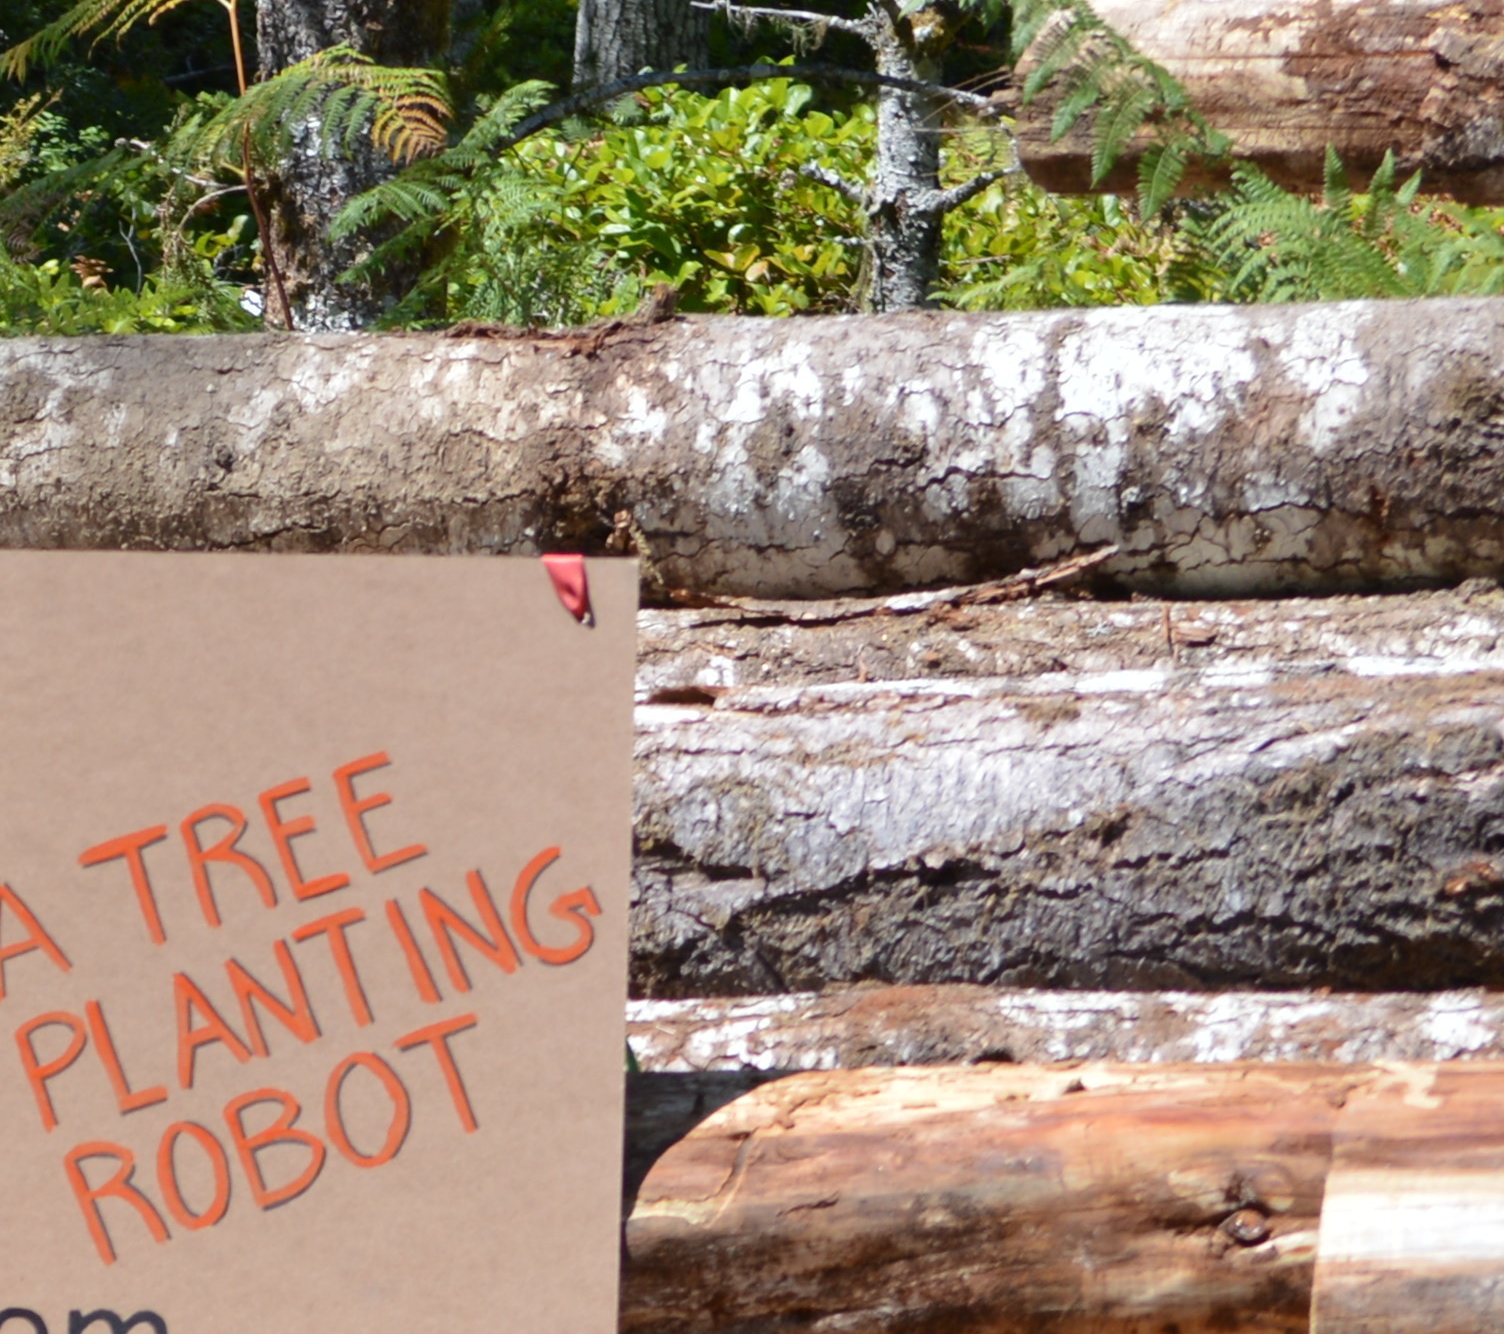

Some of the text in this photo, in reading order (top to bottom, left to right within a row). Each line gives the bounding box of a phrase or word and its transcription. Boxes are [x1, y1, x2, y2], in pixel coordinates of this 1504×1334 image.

[80, 753, 425, 942] TREE
[17, 848, 600, 1130] PLANTING
[66, 1015, 475, 1263] ROBOT
